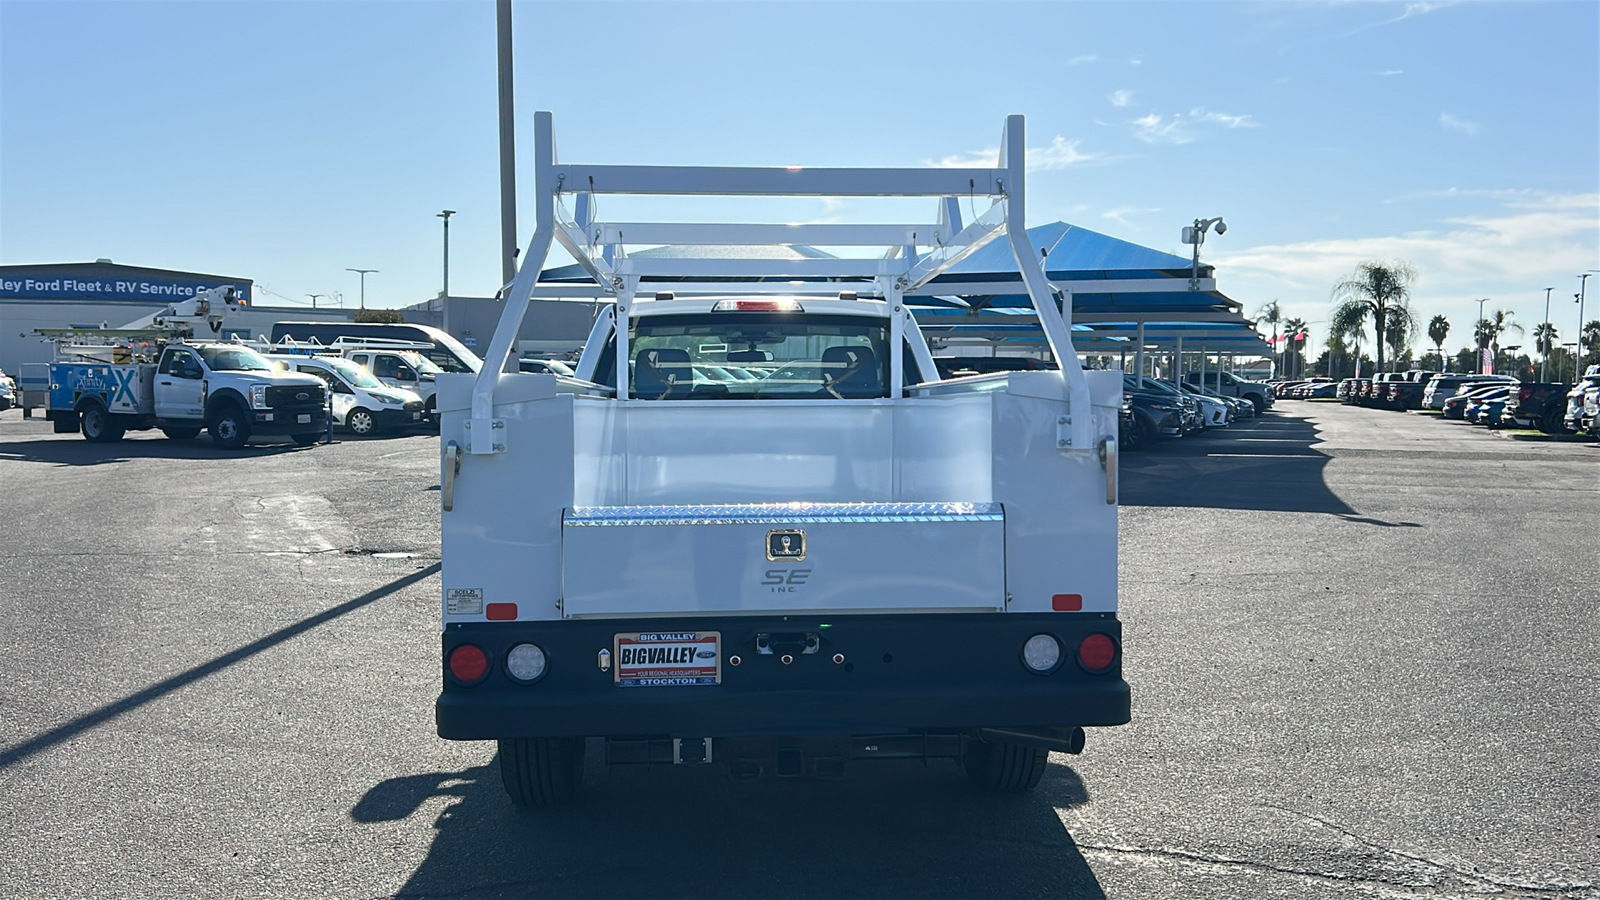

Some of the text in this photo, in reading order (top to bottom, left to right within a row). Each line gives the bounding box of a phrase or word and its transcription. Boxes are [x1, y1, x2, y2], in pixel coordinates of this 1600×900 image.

[25, 279, 60, 291] Ford
[63, 280, 102, 292] Fleet
[104, 283, 113, 293] &
[116, 281, 136, 293] RV
[140, 282, 193, 296] Service
[761, 569, 812, 585] SE
[621, 647, 697, 665] BIGVALLEY
